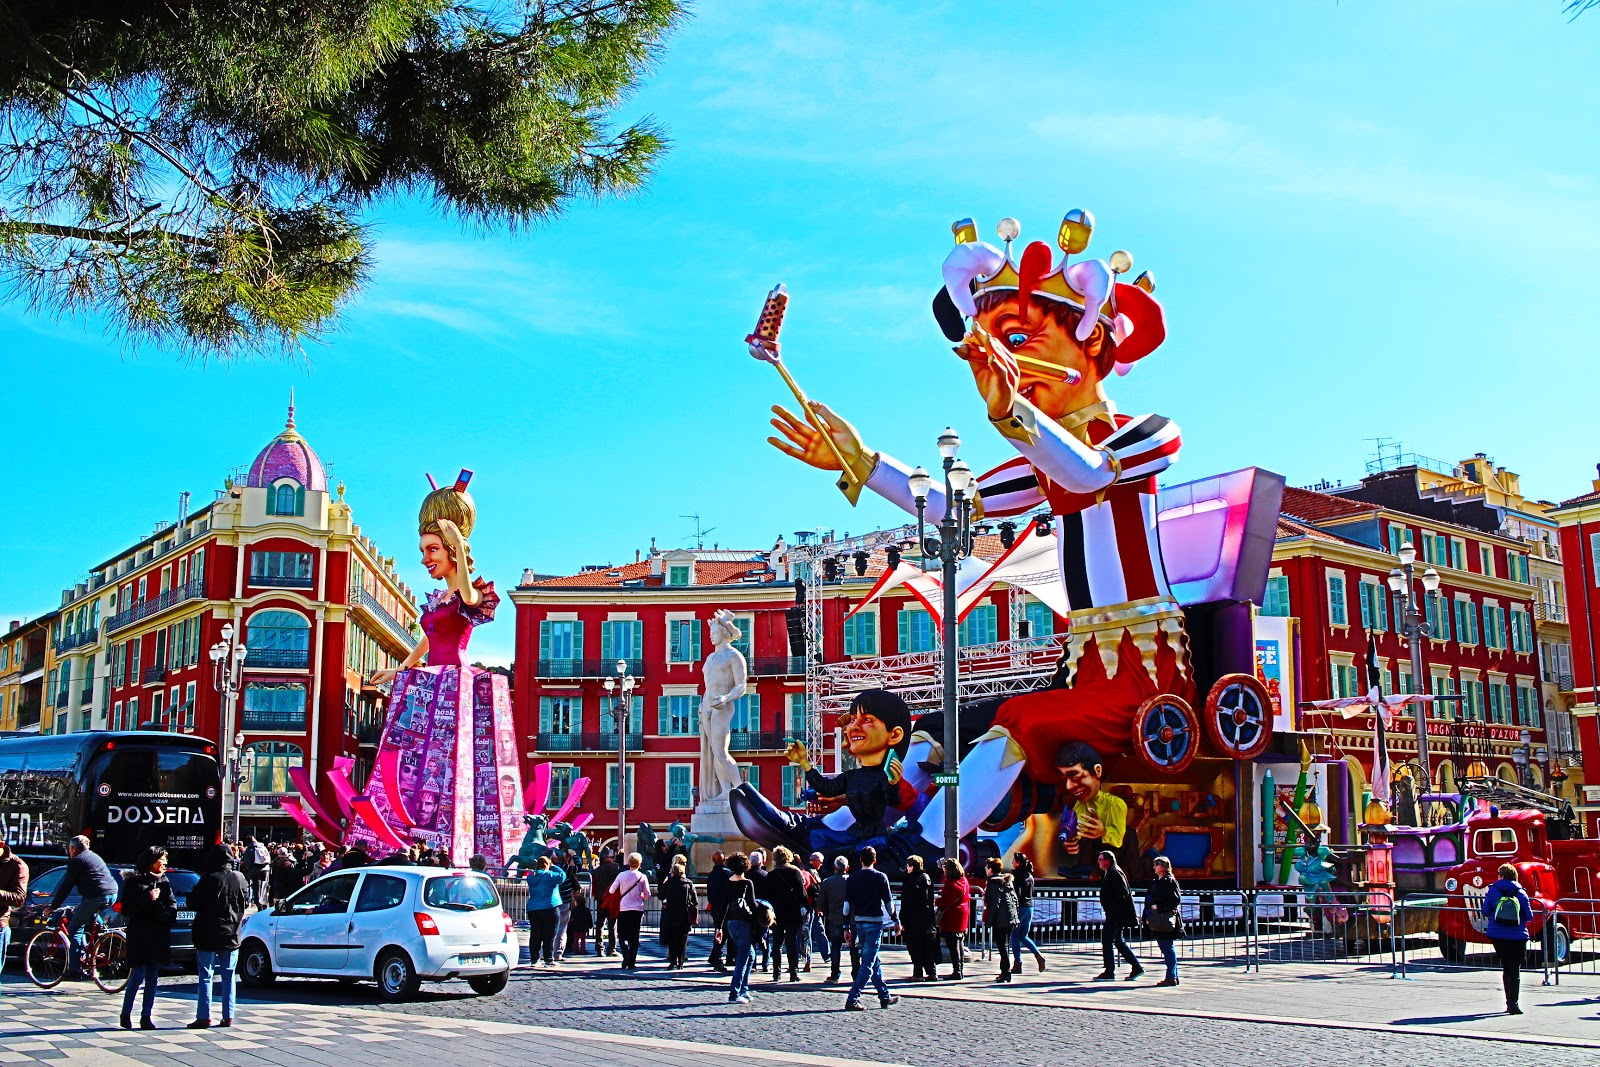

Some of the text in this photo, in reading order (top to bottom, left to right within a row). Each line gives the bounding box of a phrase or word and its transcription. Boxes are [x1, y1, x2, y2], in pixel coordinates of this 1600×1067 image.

[1490, 728, 1519, 741] D'AZUR
[935, 776, 958, 784] SORTIE
[117, 791, 200, 799] www.autoservizidossena.com
[107, 805, 205, 824] DOSSENA
